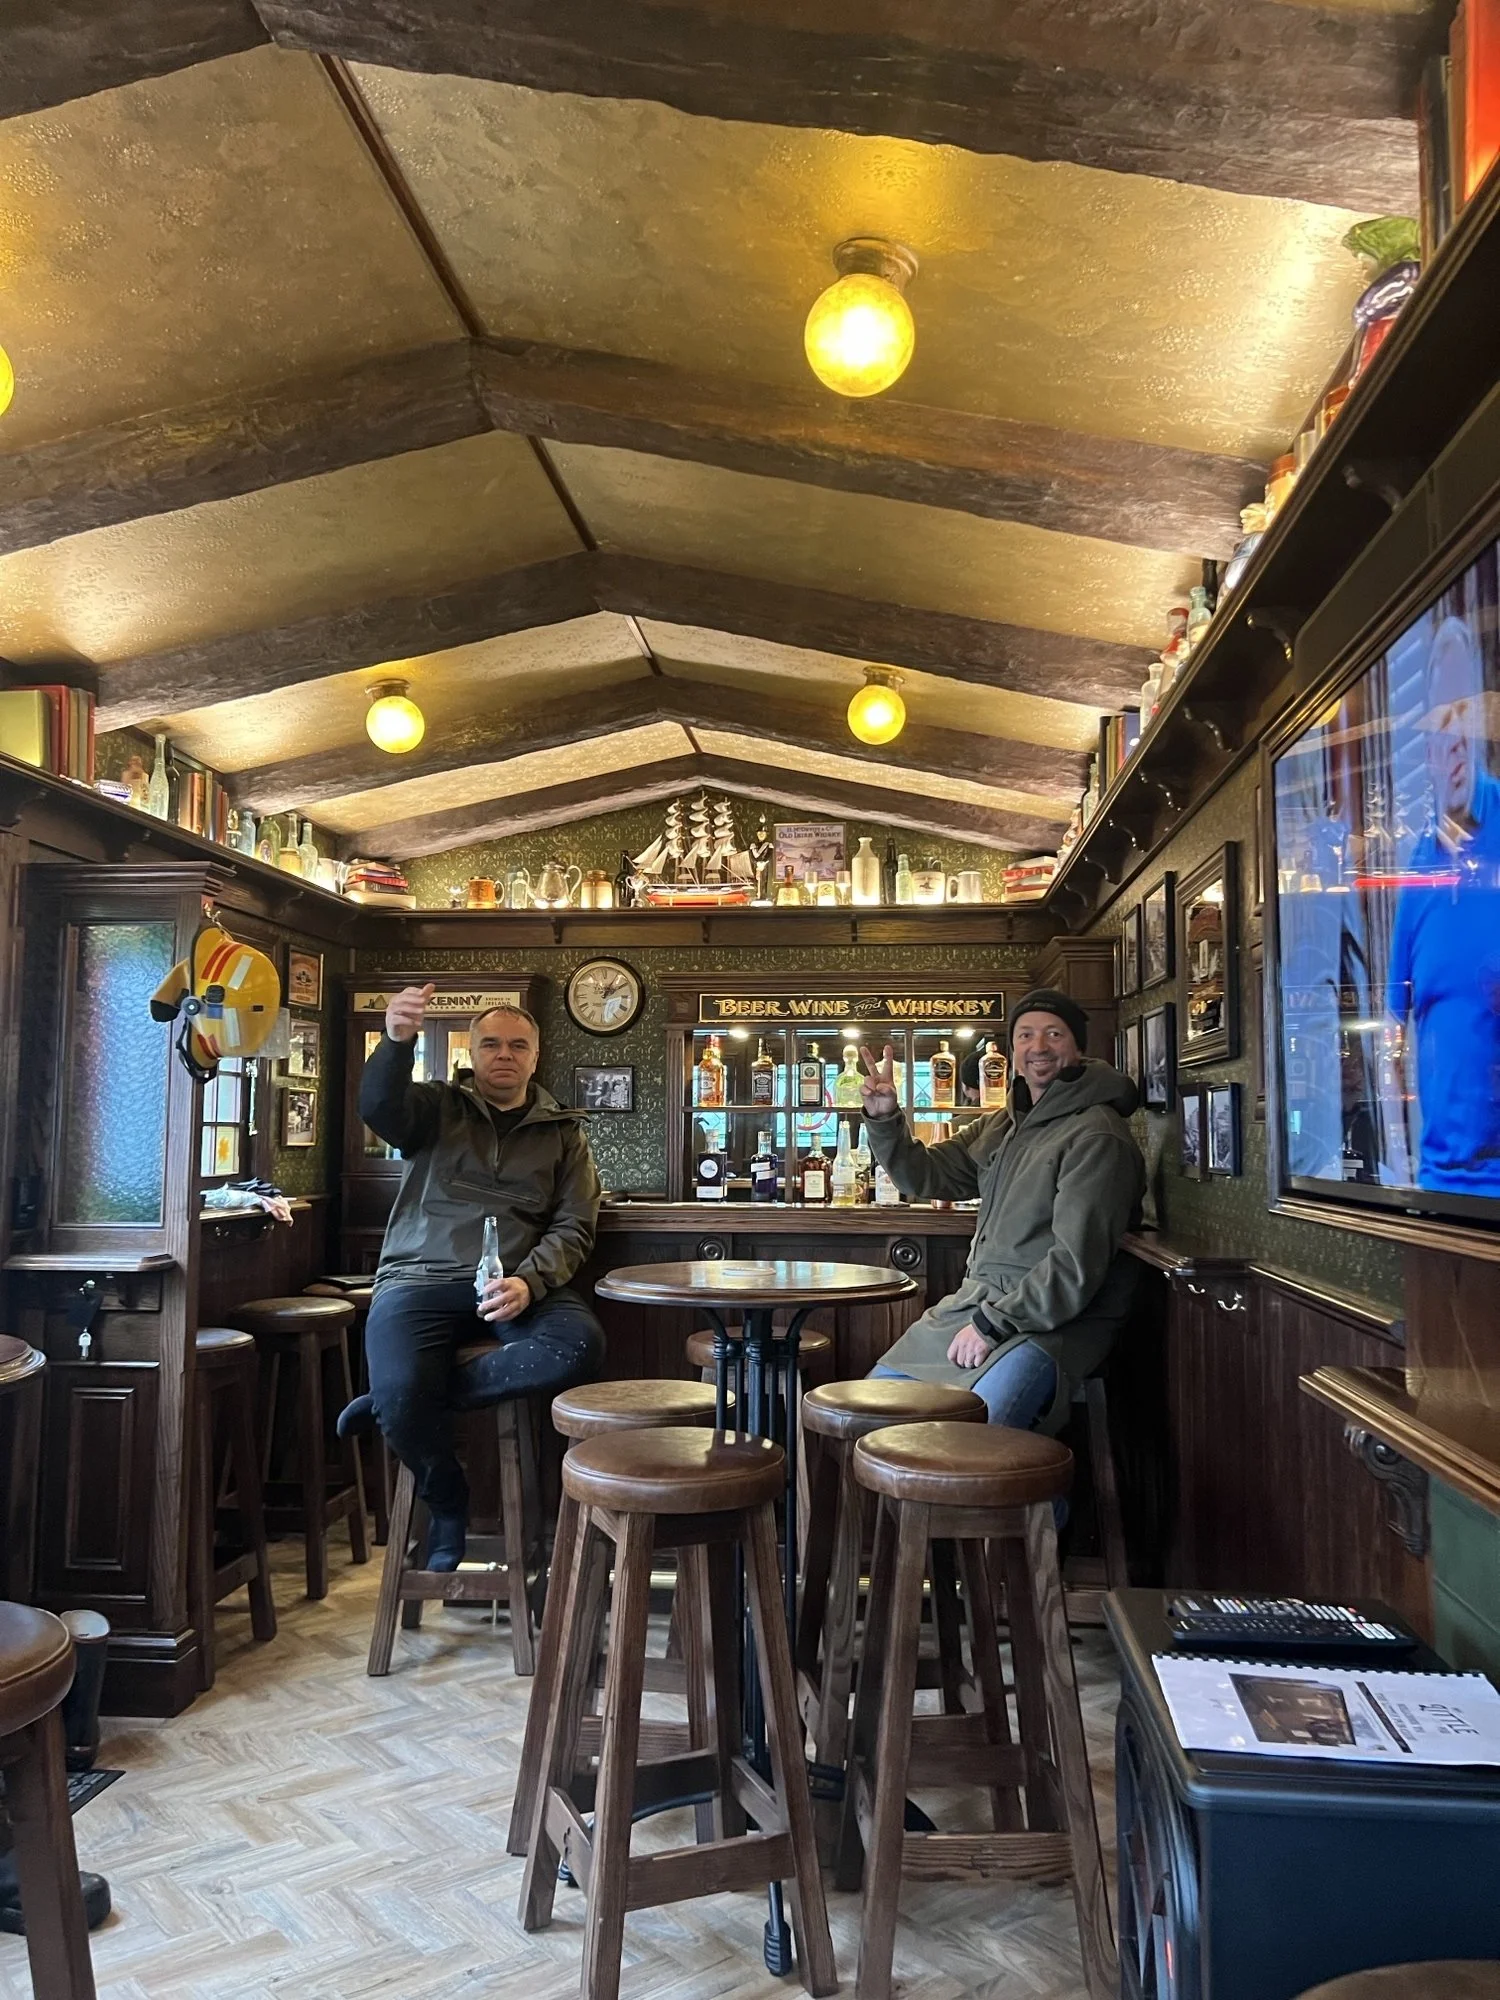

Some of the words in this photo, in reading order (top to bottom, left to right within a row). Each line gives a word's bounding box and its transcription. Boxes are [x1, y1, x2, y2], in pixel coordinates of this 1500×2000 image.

[714, 999, 790, 1016] BEER
[789, 998, 850, 1016] WINE
[886, 999, 996, 1016] WHISKEY
